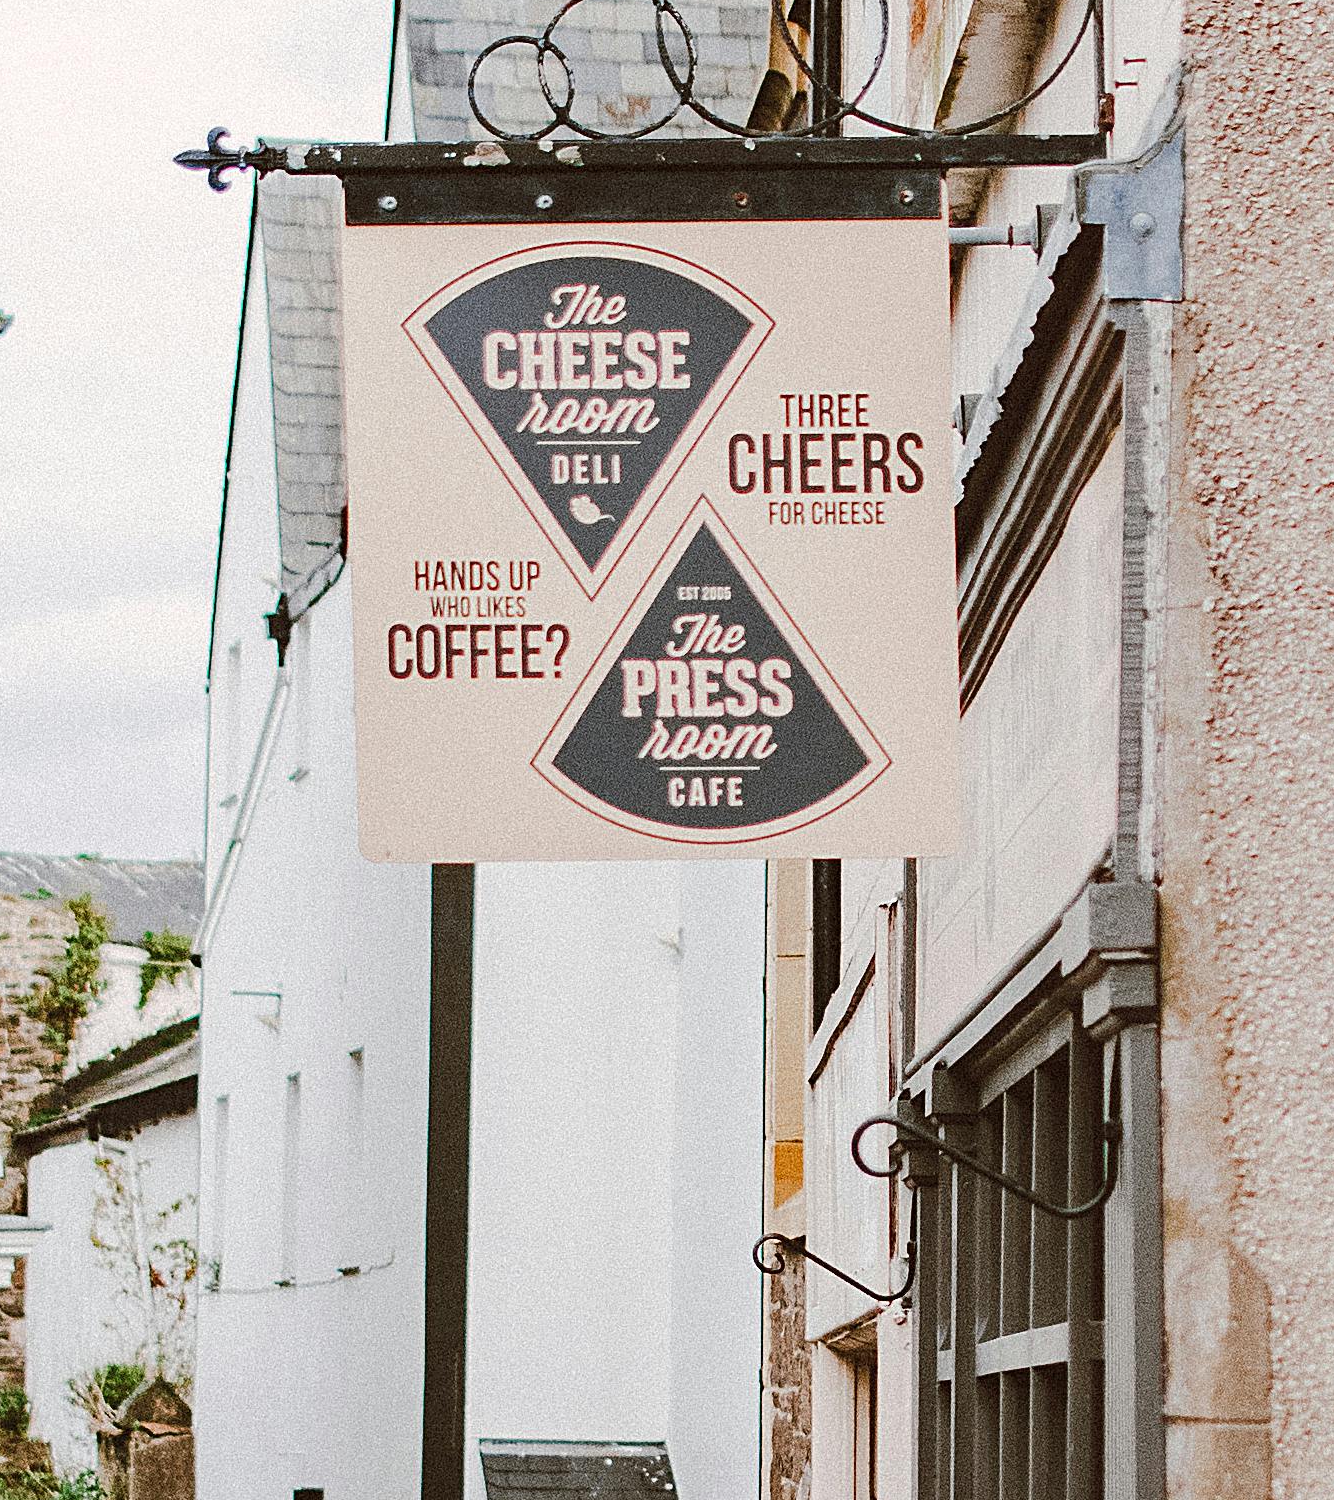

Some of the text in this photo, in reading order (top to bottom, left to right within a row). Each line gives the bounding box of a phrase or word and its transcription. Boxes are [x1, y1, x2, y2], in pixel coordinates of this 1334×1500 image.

[544, 283, 627, 329] The
[483, 330, 691, 389] CHEESE
[517, 391, 660, 434] room
[780, 394, 869, 427] THREE
[552, 453, 621, 484] DELI
[729, 432, 924, 494] CHEERS
[769, 501, 885, 525] FOR CHEESE
[415, 560, 540, 591] HANDS UP
[678, 586, 732, 600] EST 2005
[430, 596, 526, 617] WHO LIKES
[388, 624, 570, 679] COFFEE?
[666, 612, 747, 658] The
[621, 658, 794, 718] PRESS
[637, 719, 778, 760] room
[668, 777, 743, 807] CAFE
